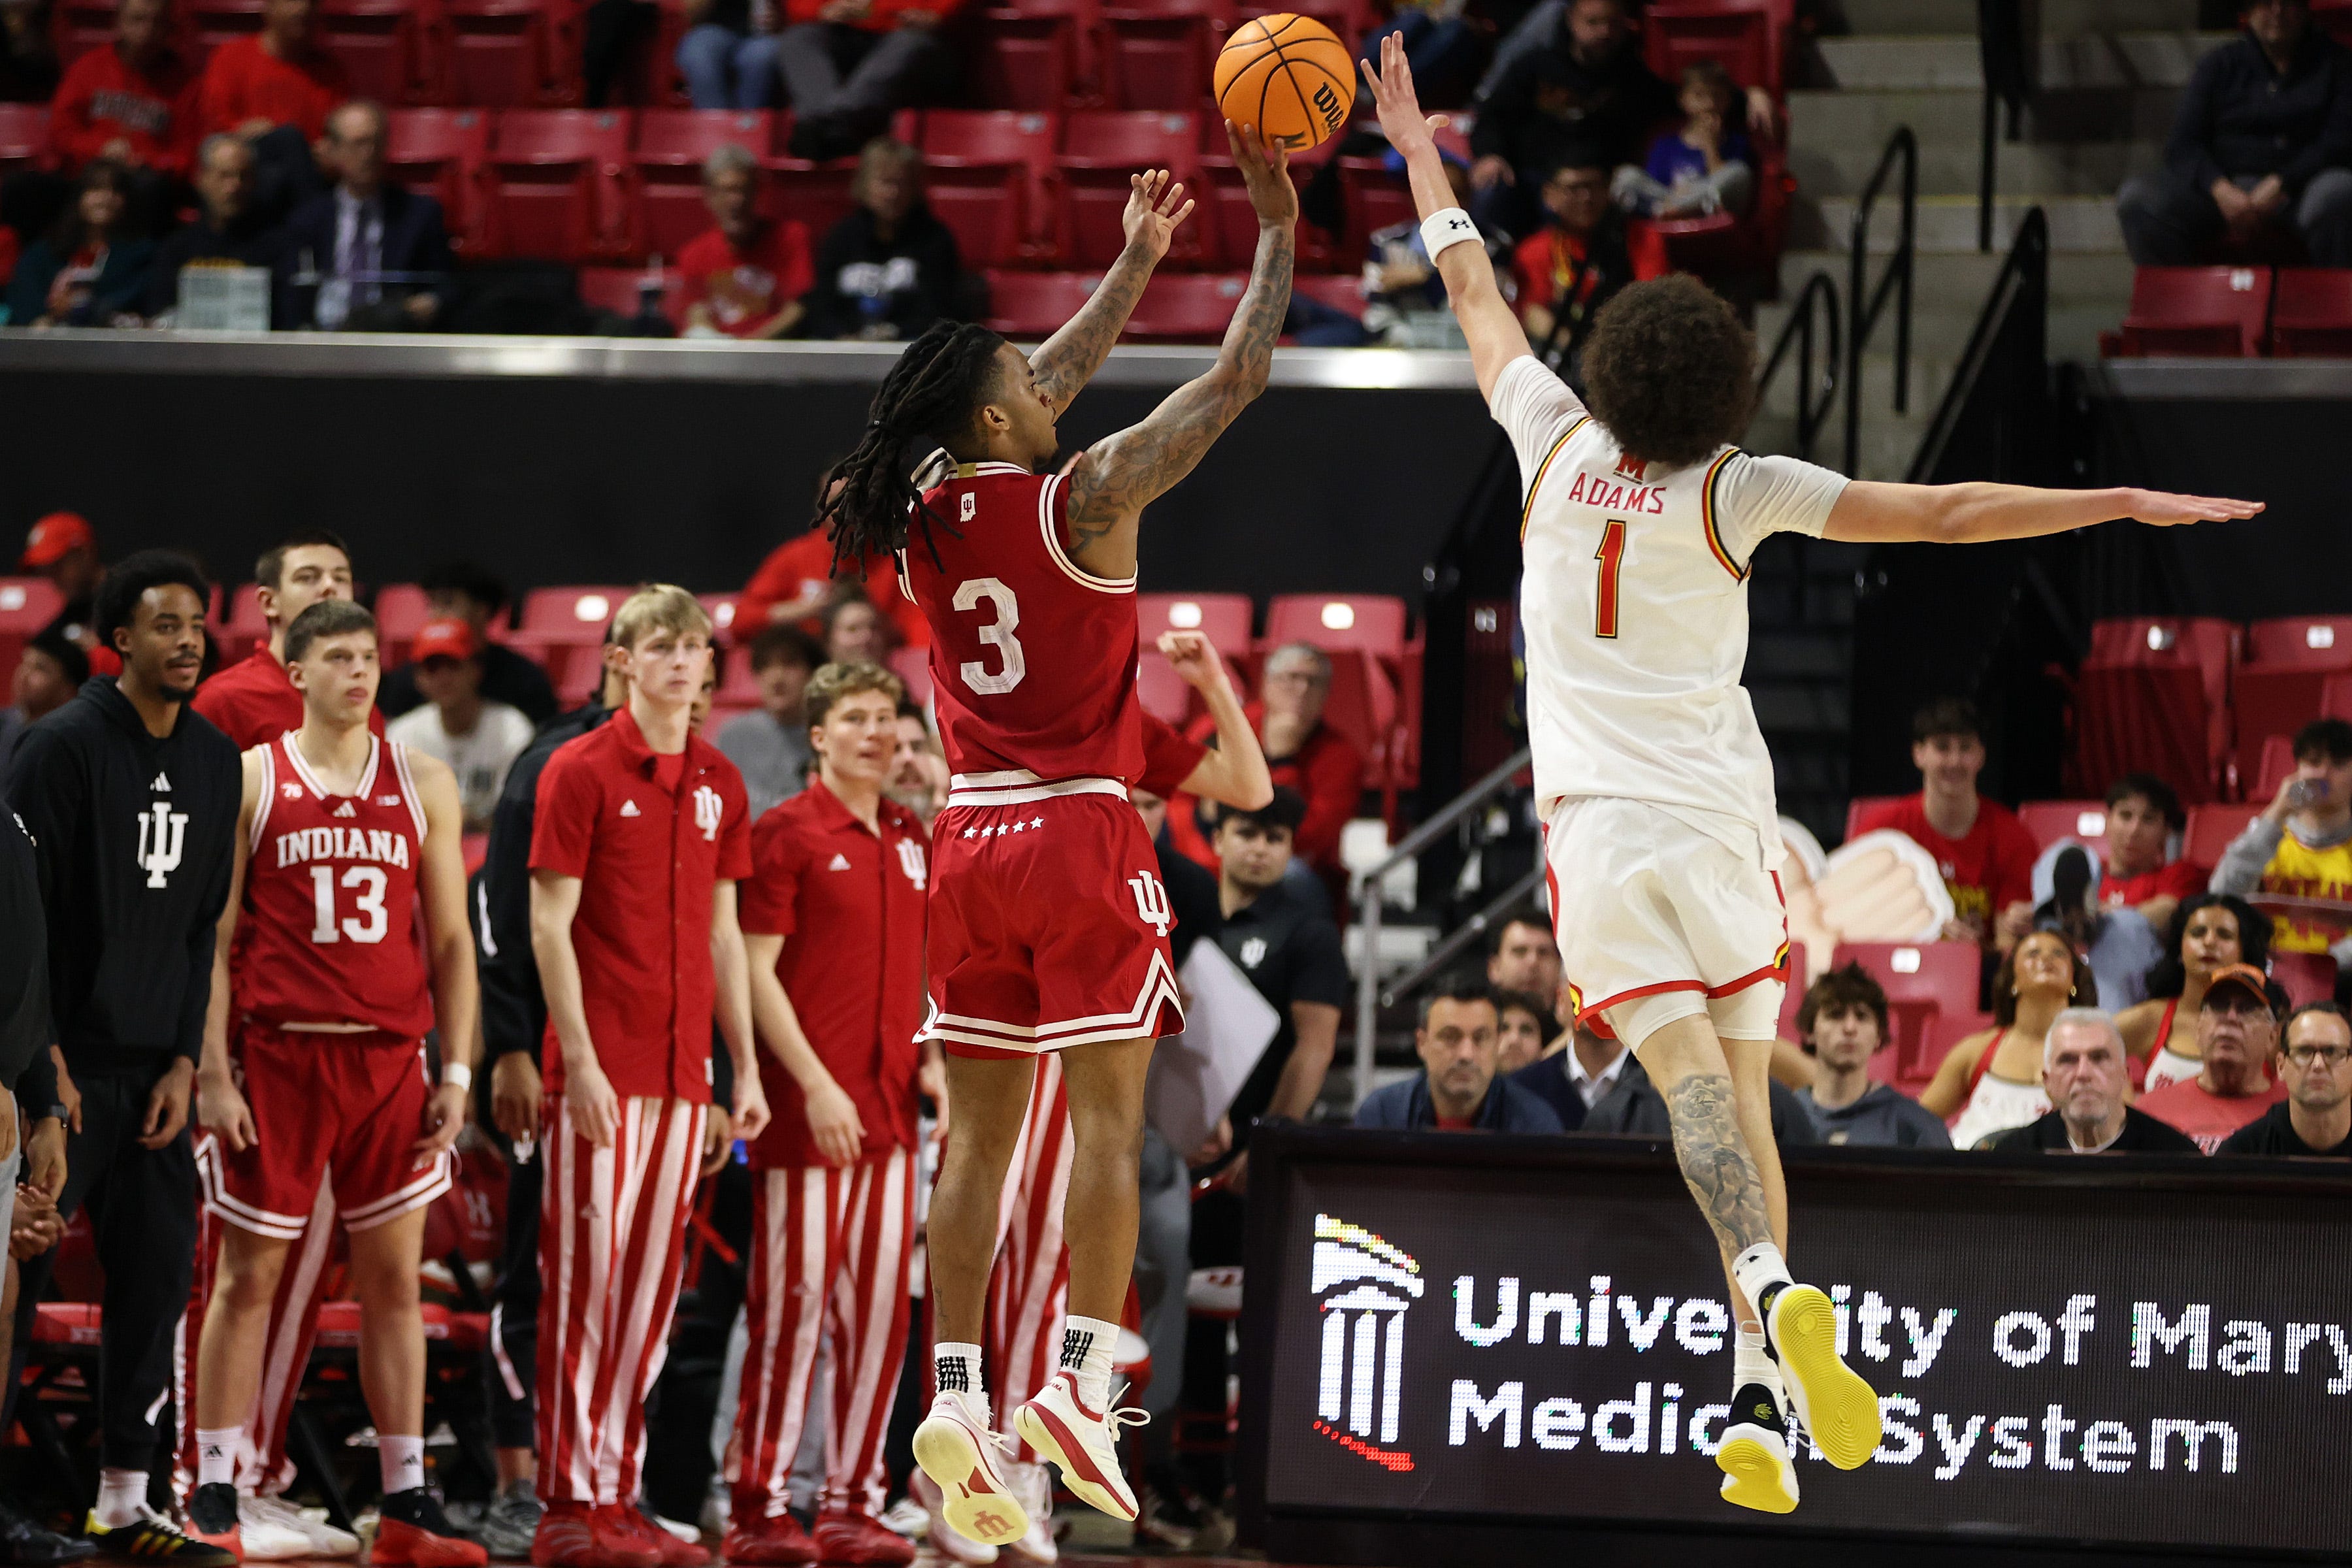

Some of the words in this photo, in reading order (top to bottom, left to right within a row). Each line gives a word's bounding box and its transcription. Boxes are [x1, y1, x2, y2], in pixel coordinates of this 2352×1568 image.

[1569, 472, 1667, 514] ADAMS
[1594, 519, 1627, 639] 1
[952, 577, 1026, 695] 3
[276, 826, 410, 870] INDIANA
[310, 865, 388, 943] 13
[1453, 1275, 1957, 1378] Univeity
[1993, 1294, 2096, 1368] of
[1871, 1392, 2238, 1481] System
